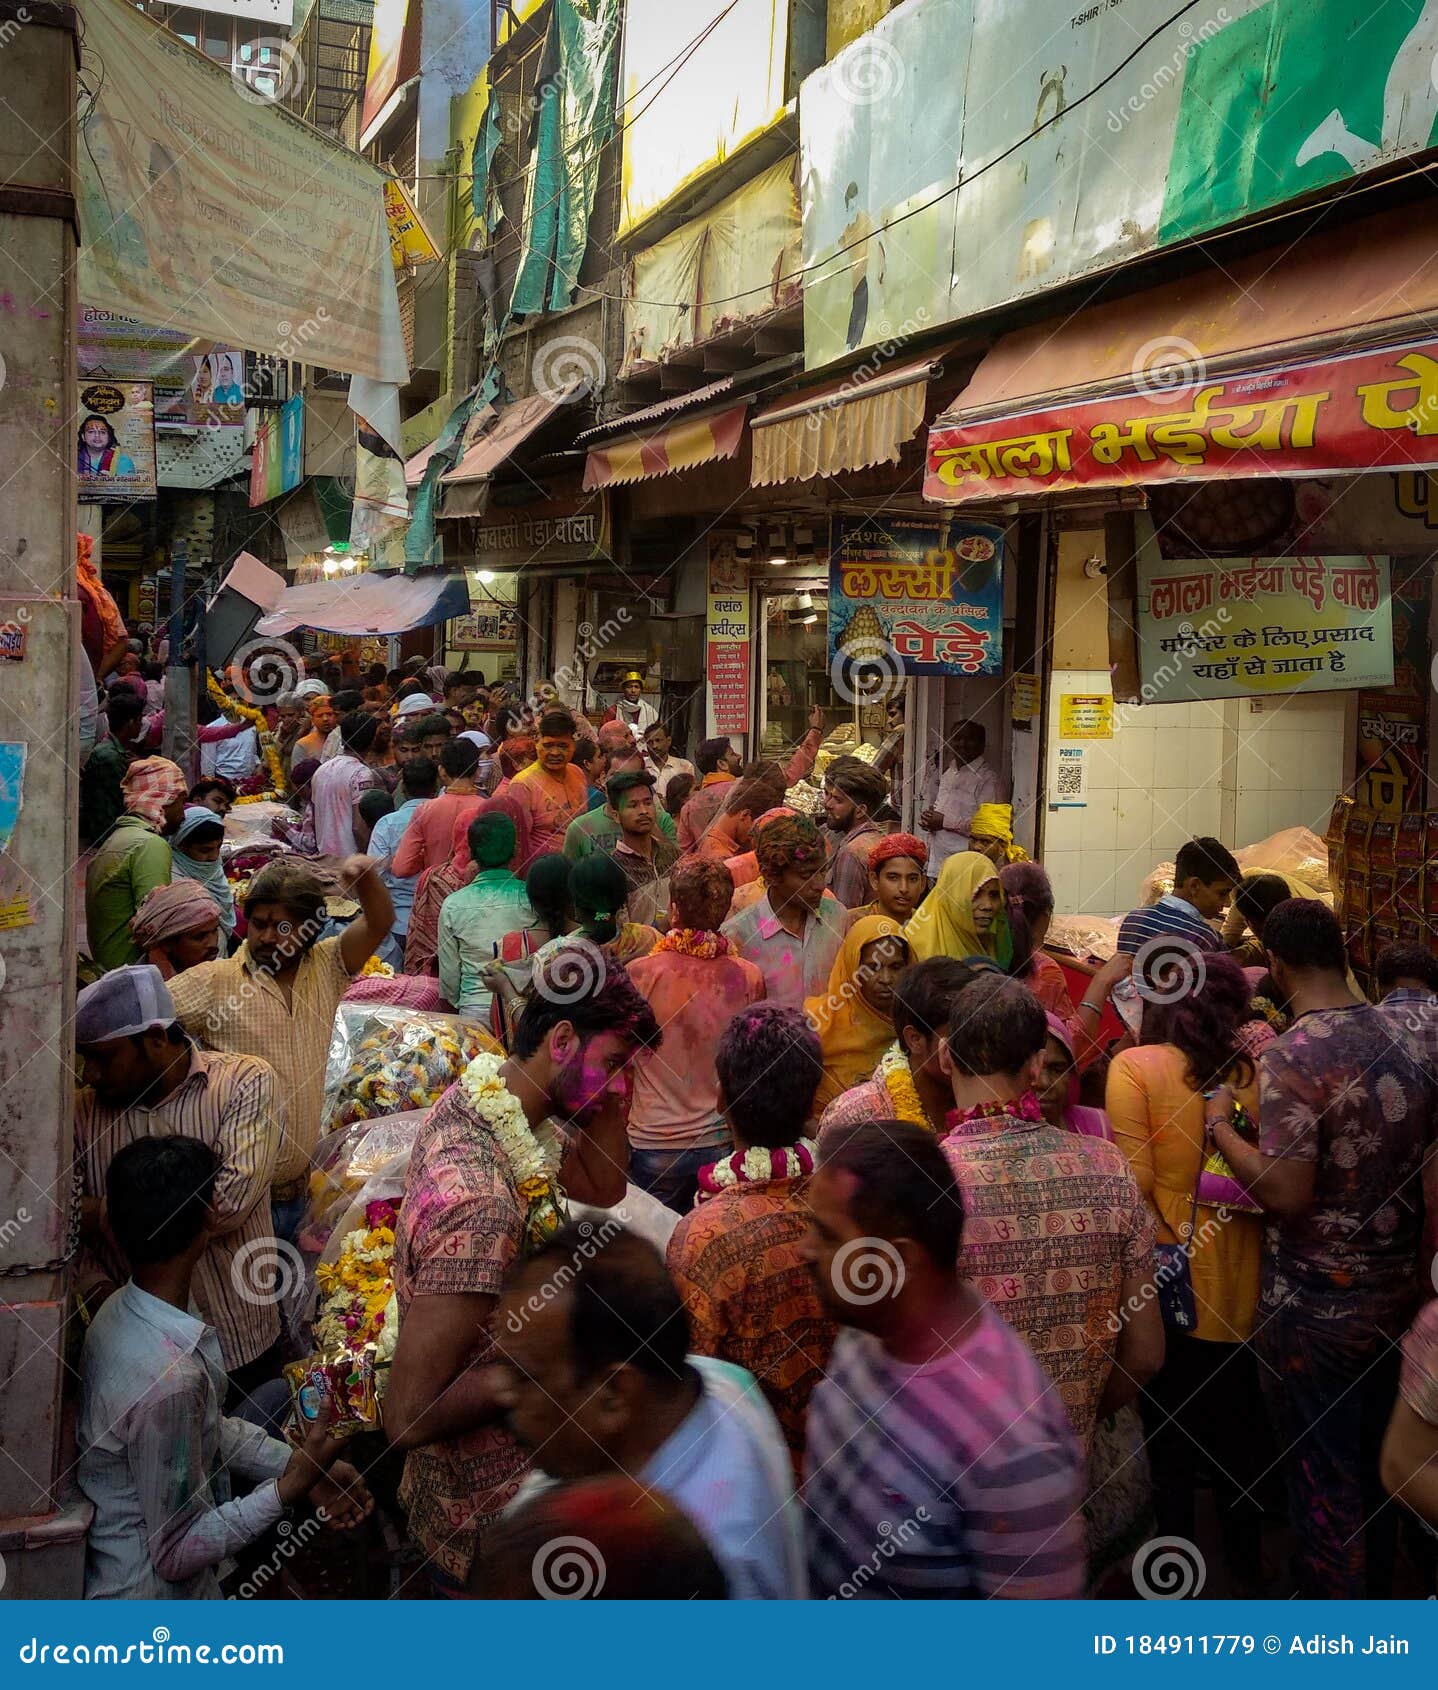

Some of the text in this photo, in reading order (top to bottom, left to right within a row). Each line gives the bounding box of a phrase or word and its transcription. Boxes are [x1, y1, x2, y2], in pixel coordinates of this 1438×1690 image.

[934, 429, 1073, 487] लाला
[1090, 384, 1330, 466] भईया
[473, 513, 521, 551] जवासी
[555, 515, 595, 544] वाला
[840, 550, 956, 600] लस्सी
[1151, 573, 1214, 618] लाला
[1220, 557, 1285, 601] भईया
[1290, 557, 1327, 611] पेड़े
[1331, 557, 1381, 611] वाले
[934, 603, 946, 614] के
[711, 619, 746, 640] स्वीट्स
[889, 620, 991, 673] पेड़े
[1160, 625, 1375, 652] मन्दिर के लिए प्रसाद
[1192, 650, 1347, 679] यहाँ से जाता है
[1360, 712, 1421, 743] स्पेशल
